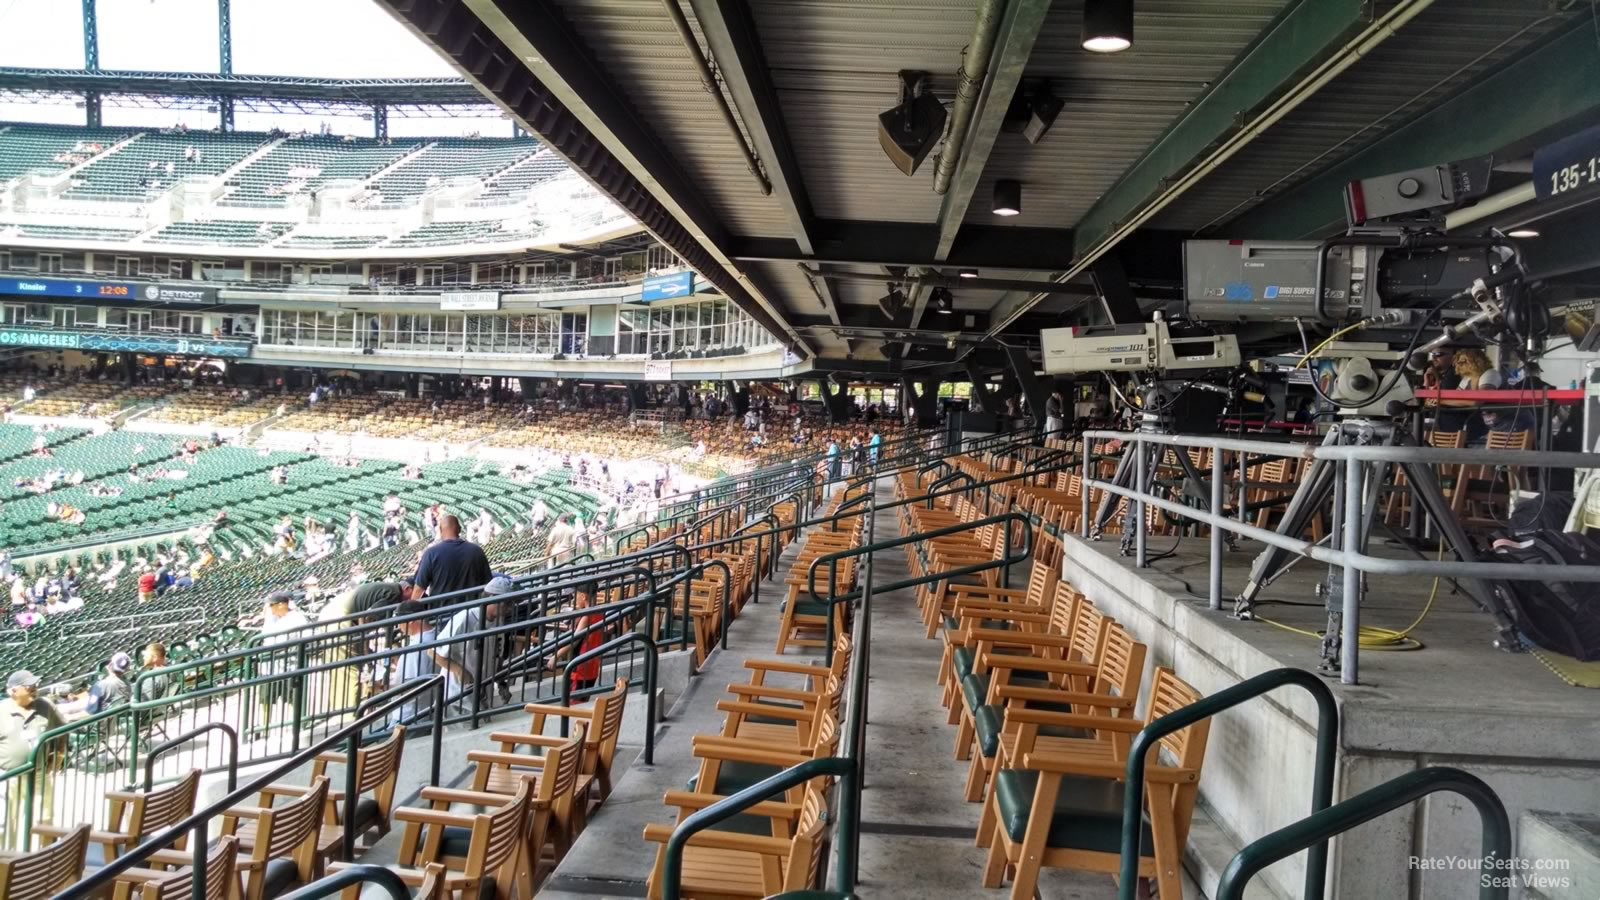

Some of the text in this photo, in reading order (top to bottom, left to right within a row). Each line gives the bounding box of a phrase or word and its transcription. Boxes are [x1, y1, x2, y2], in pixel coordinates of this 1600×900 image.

[19, 282, 47, 292] Kinsler
[160, 289, 204, 299] DETROIT
[21, 333, 76, 346] ANGELES
[1129, 343, 1144, 352] 101
